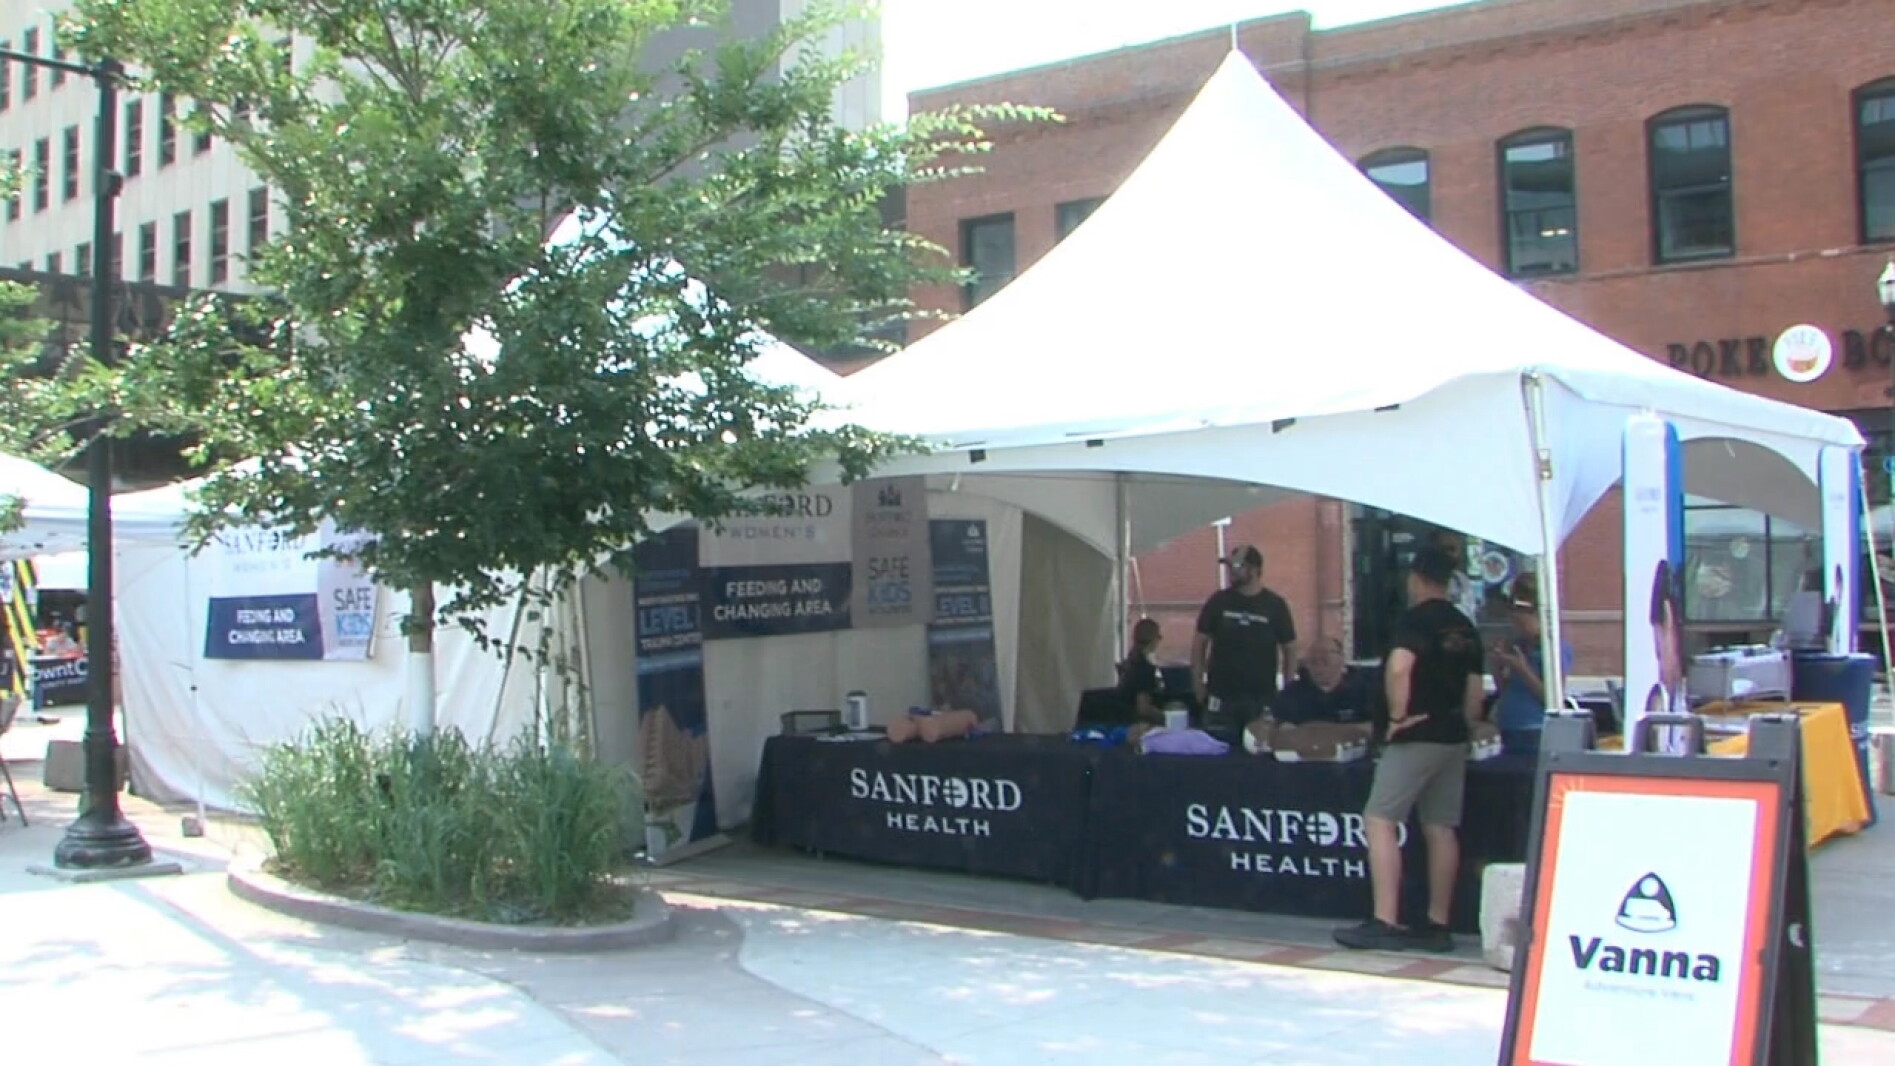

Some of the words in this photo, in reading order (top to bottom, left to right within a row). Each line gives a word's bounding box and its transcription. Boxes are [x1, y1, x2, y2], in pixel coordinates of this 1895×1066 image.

[1667, 337, 1768, 378] POKE
[868, 556, 910, 580] SAFE
[333, 587, 371, 611] SAFE
[726, 580, 787, 598] FEEDING
[791, 578, 822, 595] AND
[640, 606, 694, 635] LEVEL
[714, 601, 791, 621] CHANGING
[794, 600, 832, 617] AREA
[851, 767, 1022, 811] SANFORD
[887, 811, 991, 836] HEALTH
[1231, 852, 1366, 878] HEALTH
[1569, 934, 1721, 982] Vanna
